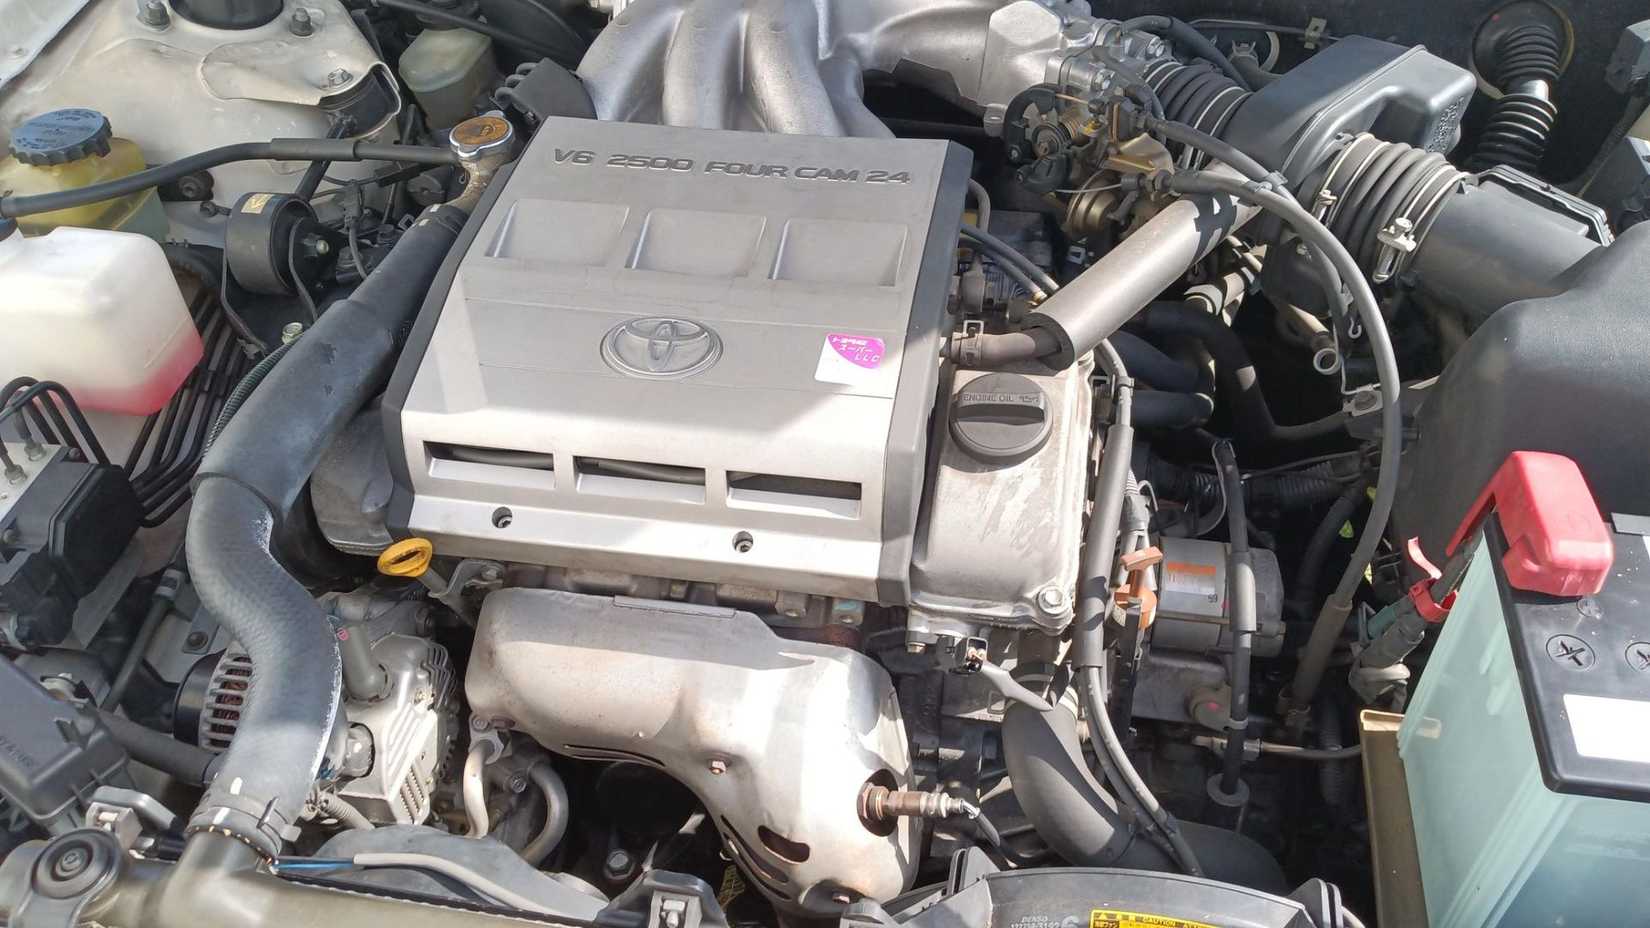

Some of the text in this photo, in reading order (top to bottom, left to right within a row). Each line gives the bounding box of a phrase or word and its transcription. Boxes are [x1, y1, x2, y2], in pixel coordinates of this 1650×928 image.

[553, 148, 912, 185] V6 2500 FOUR CAM 24
[963, 392, 1014, 402] ENGINE OIL
[1142, 915, 1177, 927] CAUTION
